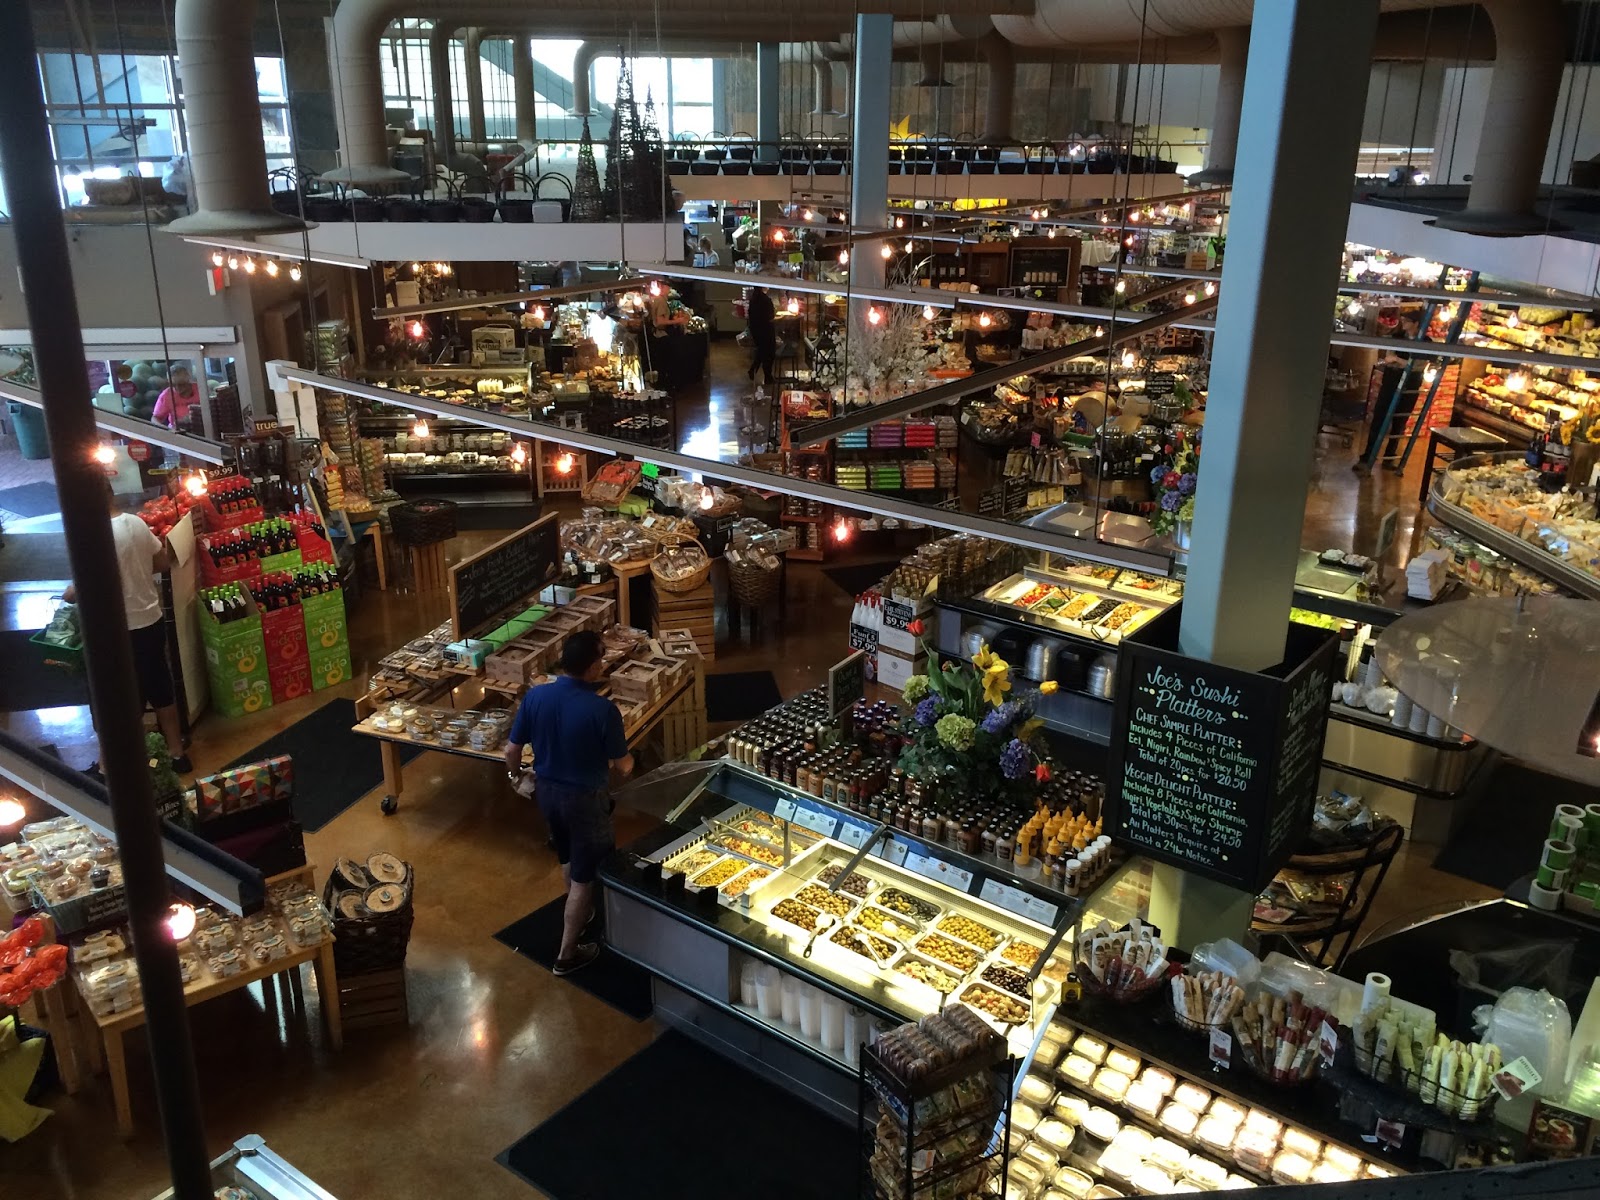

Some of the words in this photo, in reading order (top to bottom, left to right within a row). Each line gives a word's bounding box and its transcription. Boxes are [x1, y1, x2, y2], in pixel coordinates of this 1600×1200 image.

[256, 421, 278, 431] true
[208, 467, 233, 478] $9.99
[311, 620, 342, 636] eppa
[226, 645, 262, 661] eppa
[852, 638, 876, 653] $7.99
[316, 658, 347, 674] eppa
[1147, 665, 1184, 691] Joe's
[1190, 677, 1241, 707] Sushi
[1136, 707, 1158, 725] CHEF
[1160, 714, 1190, 735] SAMPLE
[1155, 689, 1226, 724] Platters
[1130, 720, 1162, 739] Includes
[1165, 731, 1173, 742] 4
[1176, 733, 1203, 752] Pieces
[1206, 745, 1216, 755] of
[1125, 762, 1153, 783] VEGGIE
[1154, 771, 1191, 795] DELIGHT
[1138, 748, 1158, 762] Total
[1158, 756, 1167, 766] of
[1197, 767, 1211, 780] for
[1210, 757, 1232, 776] Spicy
[1234, 764, 1251, 779] Roll
[1124, 776, 1154, 796] Includes
[1156, 788, 1163, 798] 8
[1165, 790, 1193, 808] Pieces
[1195, 802, 1207, 812] of
[1130, 802, 1150, 819] Total
[1152, 809, 1162, 821] of
[1192, 823, 1204, 836] for
[1145, 796, 1180, 818] Vegetable
[1183, 808, 1206, 826] Spicy
[1208, 817, 1242, 840] Shrimp
[1130, 829, 1153, 845] Least
[1142, 819, 1174, 839] Platters
[1177, 832, 1208, 851] Require
[1210, 846, 1220, 855] at
